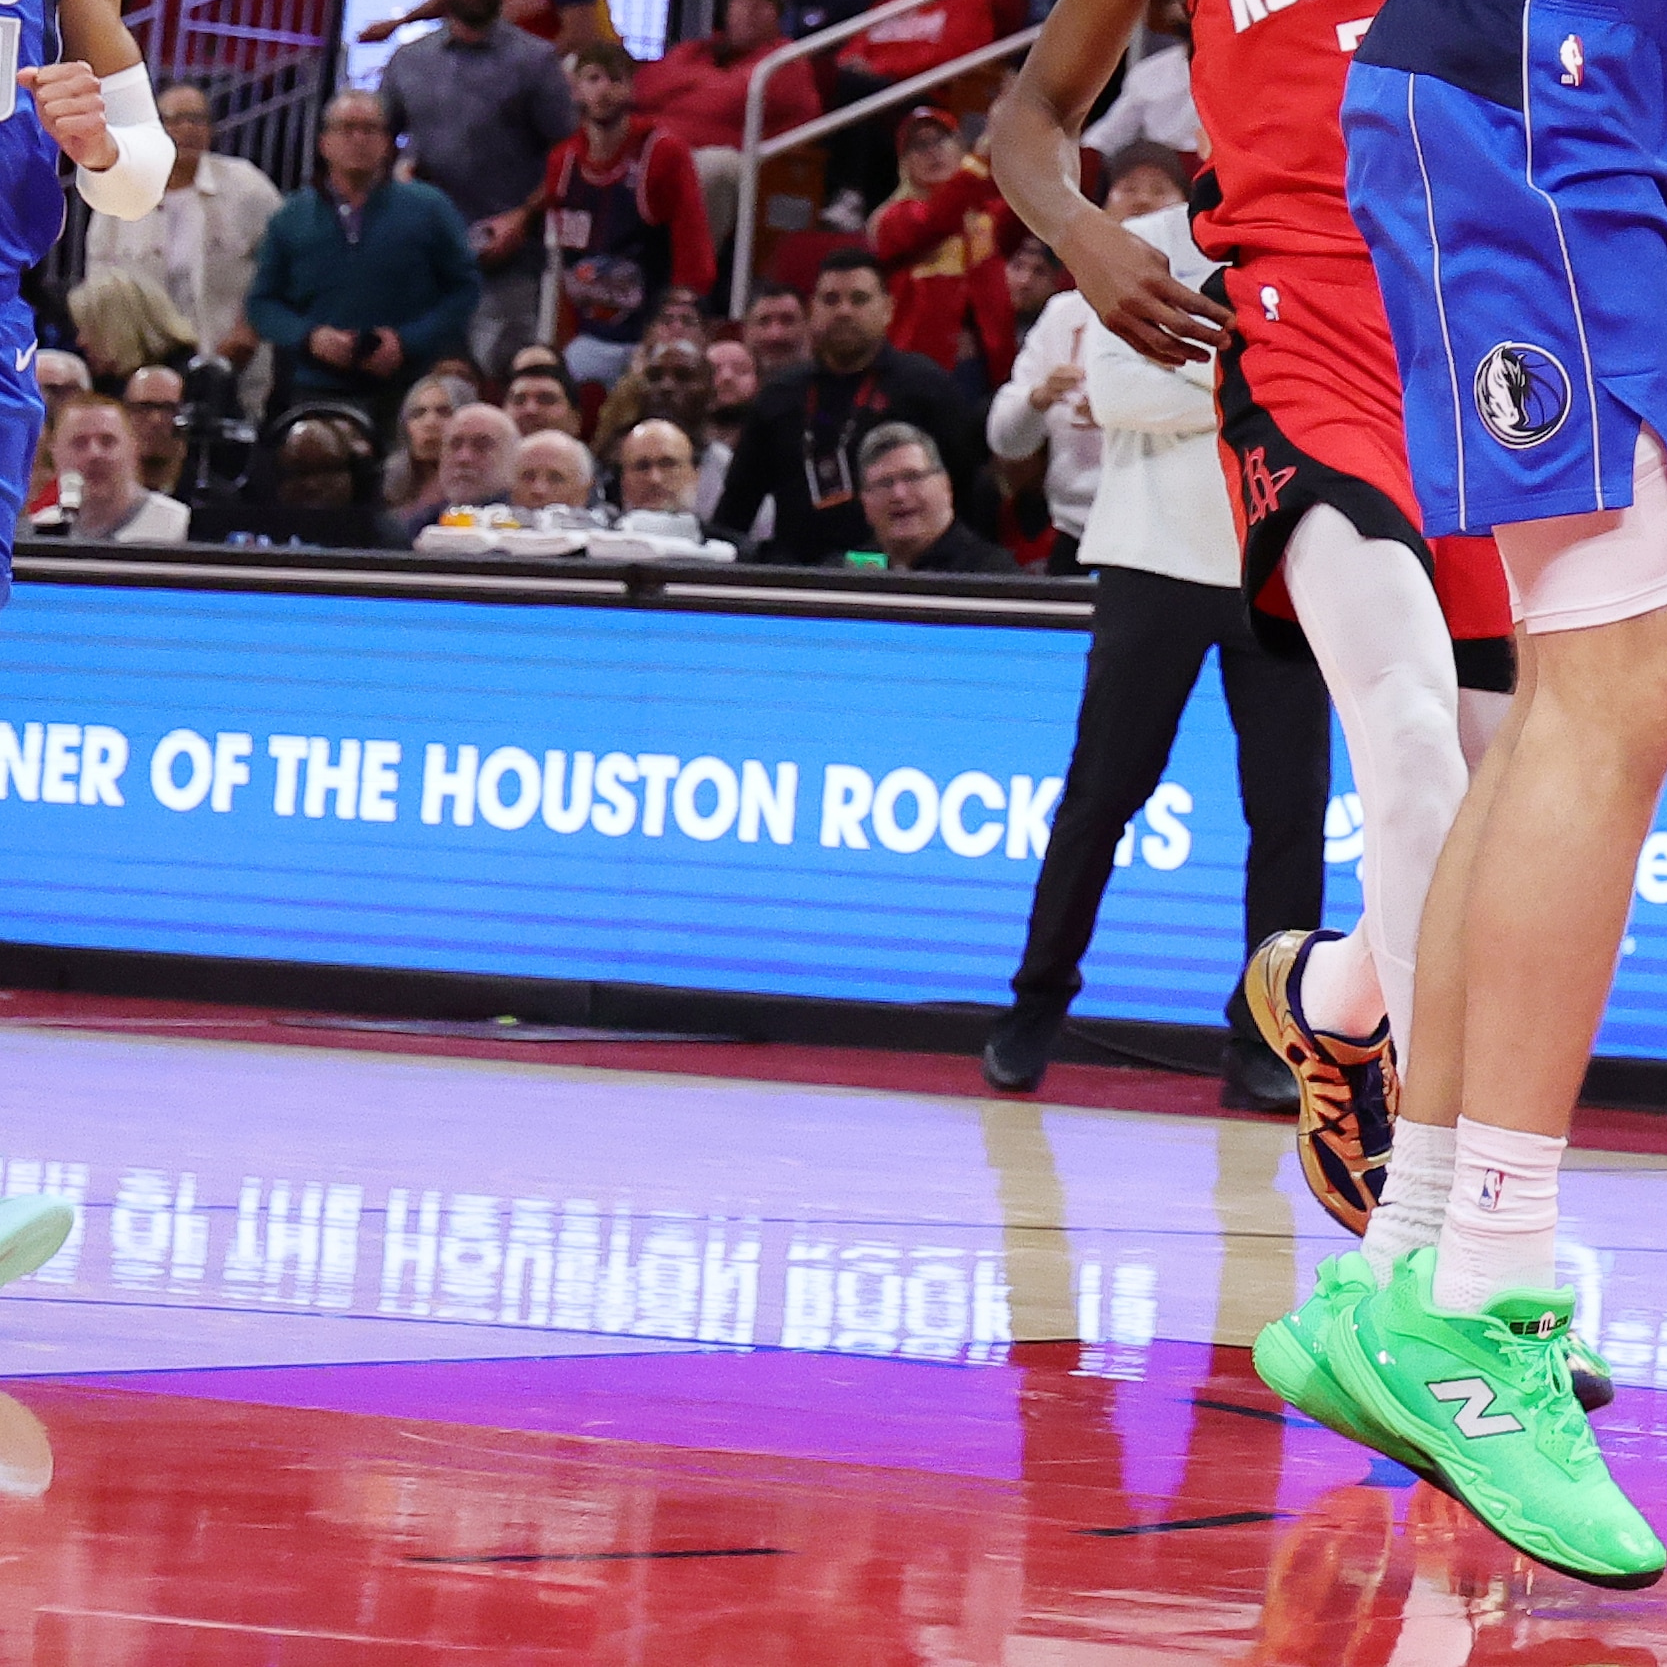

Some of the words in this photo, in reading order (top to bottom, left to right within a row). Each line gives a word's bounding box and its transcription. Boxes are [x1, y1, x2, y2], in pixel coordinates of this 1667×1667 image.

[150, 727, 254, 813] OF
[267, 733, 402, 823] THE
[420, 741, 798, 847] HOUSTON
[819, 763, 1194, 871] ROCKS
